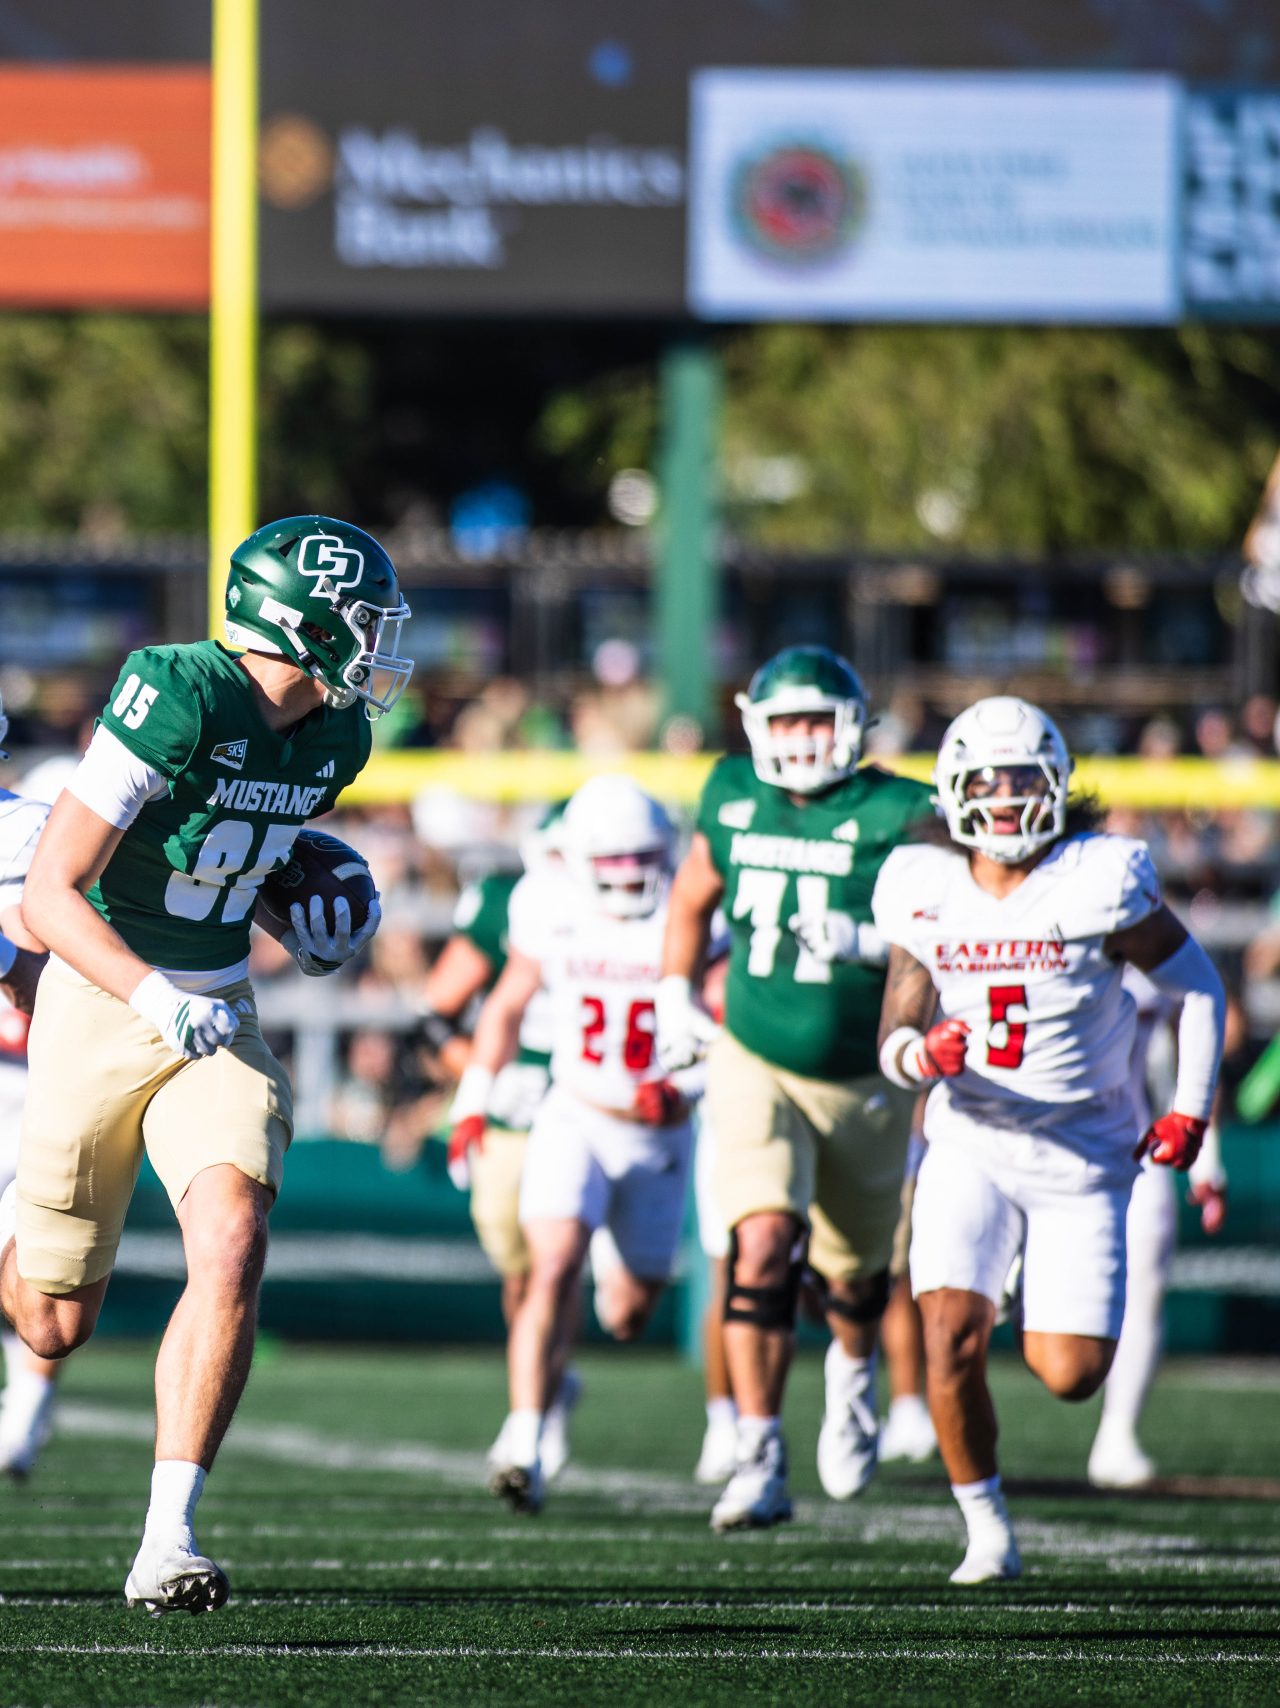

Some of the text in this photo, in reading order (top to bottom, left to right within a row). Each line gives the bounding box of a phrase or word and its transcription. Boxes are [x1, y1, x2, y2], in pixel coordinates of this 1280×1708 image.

[338, 128, 683, 205] Mechanics
[335, 202, 504, 268] Bank
[111, 672, 160, 730] 85
[206, 777, 327, 816] MUSTANG
[732, 867, 833, 985] 71
[935, 940, 1065, 959] EASTERN
[937, 958, 1070, 973] WASHINGTON
[580, 995, 656, 1076] 26
[986, 984, 1028, 1070] 5
